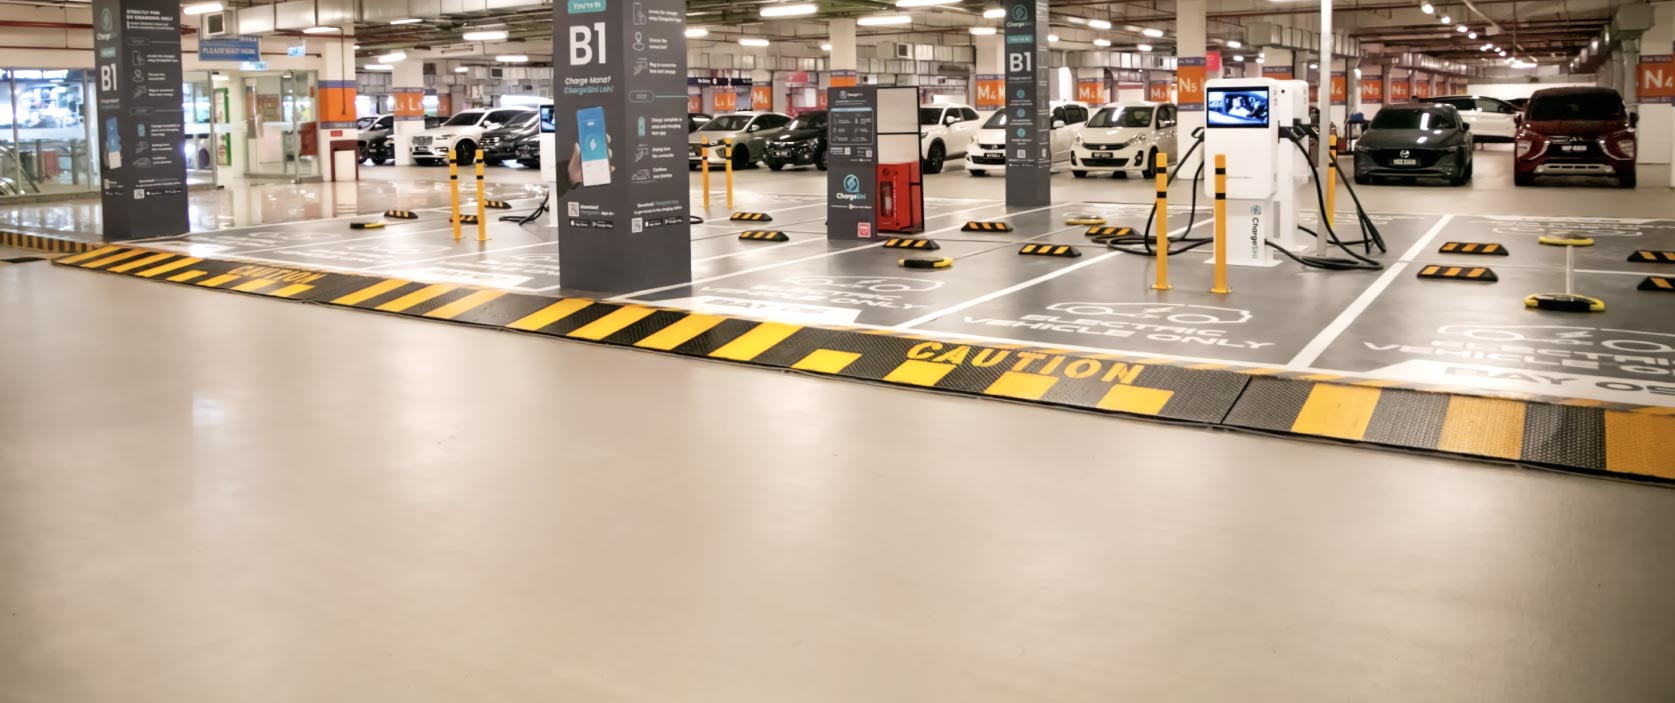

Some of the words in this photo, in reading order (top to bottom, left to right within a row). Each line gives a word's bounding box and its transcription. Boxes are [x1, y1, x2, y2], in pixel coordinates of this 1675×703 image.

[569, 22, 606, 66] B1
[1009, 52, 1031, 72] B1
[101, 63, 117, 91] B1
[564, 77, 588, 86] Charge
[590, 76, 611, 84] Mana?
[1179, 77, 1197, 92] N5
[1645, 69, 1673, 88] N4
[753, 91, 768, 104] M4
[978, 85, 996, 99] M4
[1251, 217, 1260, 258] ChargeSini
[227, 265, 328, 284] CAUTION
[830, 297, 922, 310] ONLY
[963, 316, 1136, 338] VEHICLE
[1147, 332, 1276, 349] ONLY
[1021, 314, 1227, 337] ELECTRIC
[907, 341, 1145, 385] CAUTION
[1363, 342, 1599, 369] VEHICLE
[1431, 340, 1675, 366] ELECTRI
[1443, 366, 1581, 385] BAY
